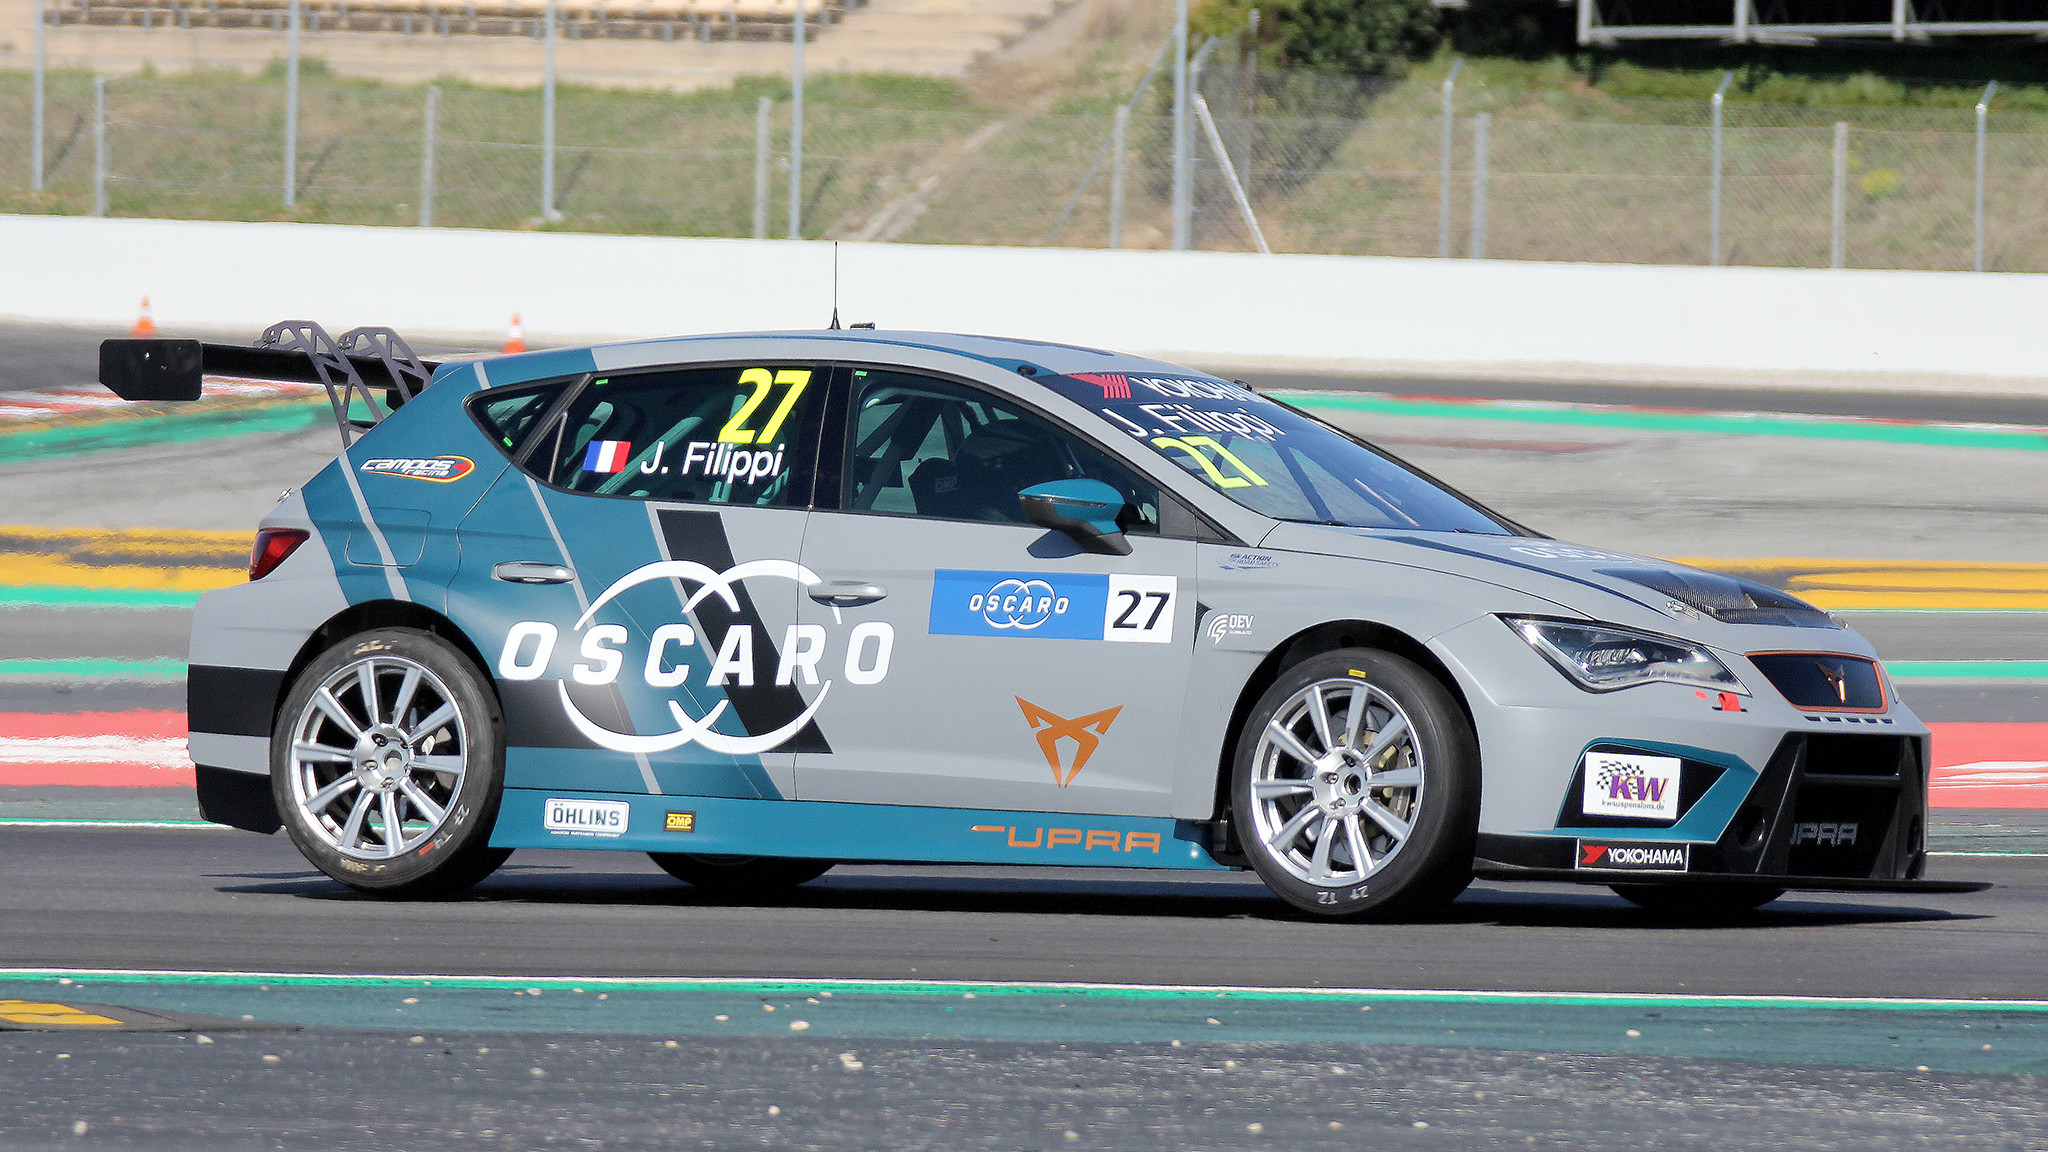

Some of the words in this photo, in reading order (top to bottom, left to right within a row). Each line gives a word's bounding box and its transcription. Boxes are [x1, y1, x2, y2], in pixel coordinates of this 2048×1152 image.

[717, 368, 812, 444] 27
[1102, 408, 1165, 438] J.
[1138, 403, 1286, 442] Filippi
[640, 441, 668, 476] J.
[682, 442, 786, 485] Filippi
[1150, 435, 1269, 489] 27
[1241, 553, 1272, 561] ACTION
[968, 593, 1070, 615] OSCARO
[1112, 589, 1171, 631] 27
[1229, 614, 1255, 629] QEV
[499, 621, 895, 687] OSCARO
[1609, 774, 1669, 802] KW
[553, 802, 620, 827] ÖHLINS
[666, 815, 692, 827] OMP
[1608, 848, 1684, 865] YOKOHAMA
